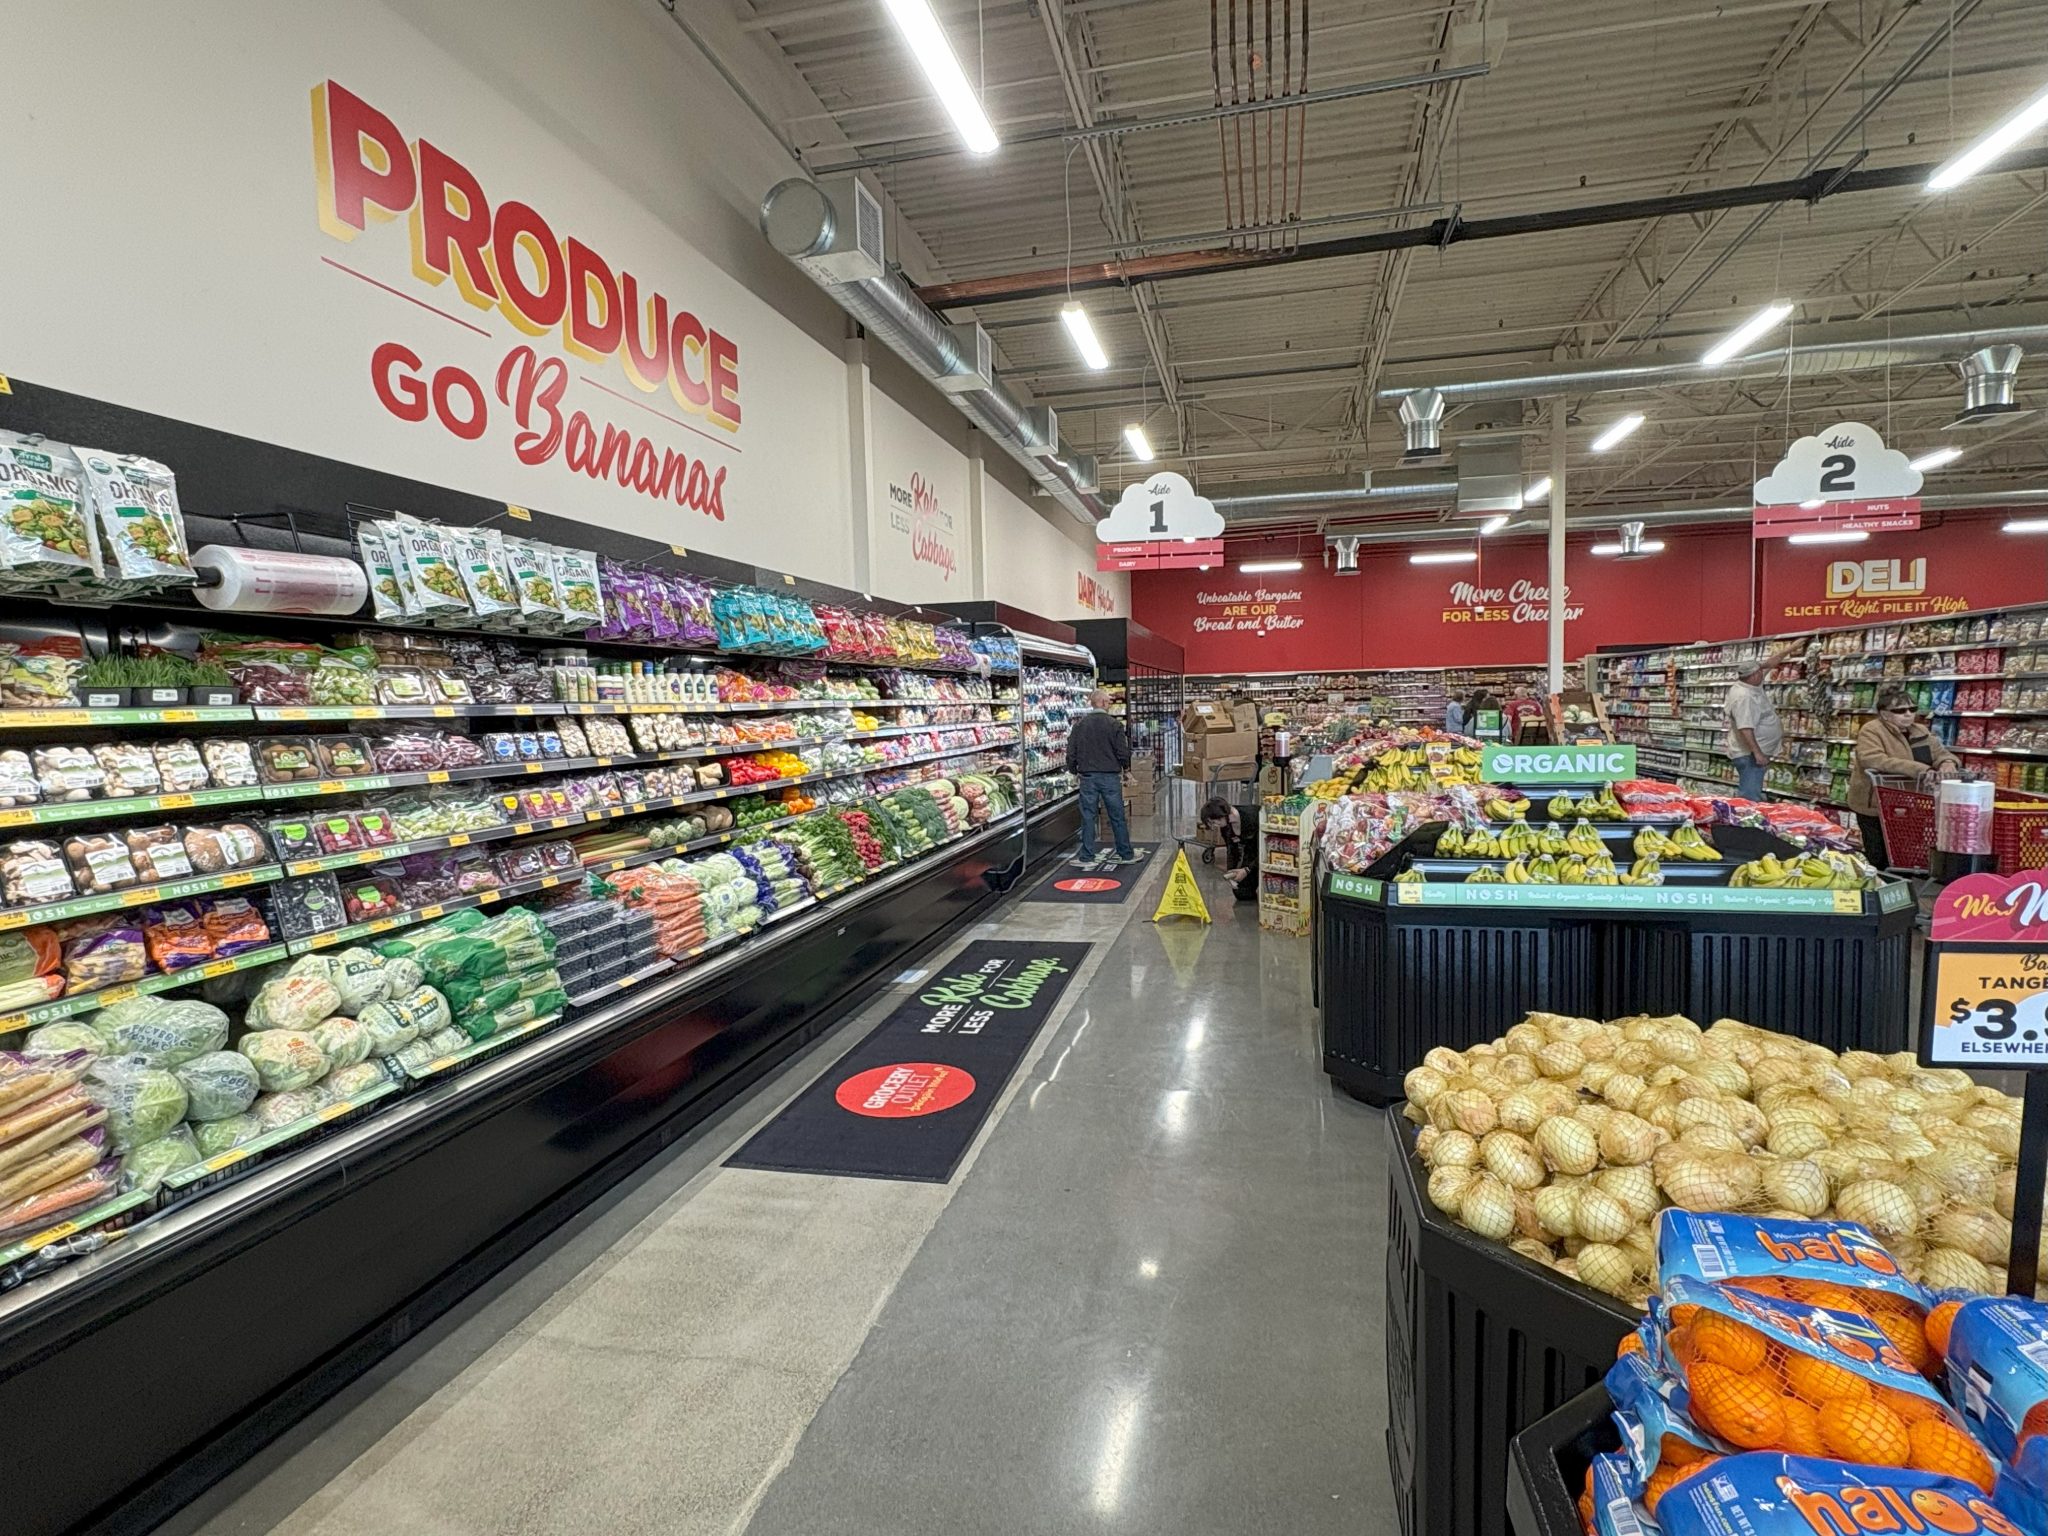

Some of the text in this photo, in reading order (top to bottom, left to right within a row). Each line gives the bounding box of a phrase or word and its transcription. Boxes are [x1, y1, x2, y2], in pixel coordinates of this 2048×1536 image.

[311, 79, 742, 433] PRODUCE
[371, 342, 727, 521] GO Bananas
[1824, 436, 1855, 449] Aisle
[1820, 454, 1857, 493] 2
[889, 482, 913, 508] MORE
[1148, 484, 1171, 496] Aisle
[890, 511, 910, 535] LESS
[1149, 500, 1168, 533] 1
[1842, 519, 1914, 529] HEALTHY SNACKS
[1826, 558, 1927, 599] DELI
[1196, 588, 1302, 605] Unbeatable Bargains
[1450, 580, 1506, 607] More
[1222, 604, 1277, 616] ARE OUR
[1442, 611, 1471, 623] FOR
[1475, 609, 1510, 622] LESS
[1784, 595, 1969, 619] SLICE IT Right. PILE IT High.
[1193, 614, 1304, 632] Bread and Butter
[1491, 752, 1626, 774] ORGANIC
[173, 882, 209, 896] NOSH
[1335, 878, 1374, 896] NOSH
[1467, 889, 1519, 900] NOSH
[1657, 892, 1714, 905] NOSH
[919, 959, 1007, 1033] MORE Kale FOR
[957, 957, 1069, 1035] LESS Cabbage.
[26, 1003, 72, 1024] NOSH
[1950, 997, 2048, 1042] $3.
[1961, 1042, 2048, 1054] ELSEWHE
[862, 1067, 915, 1109] GROCERY
[890, 1072, 932, 1104] OUTLET
[1776, 1475, 2026, 1536] halos
